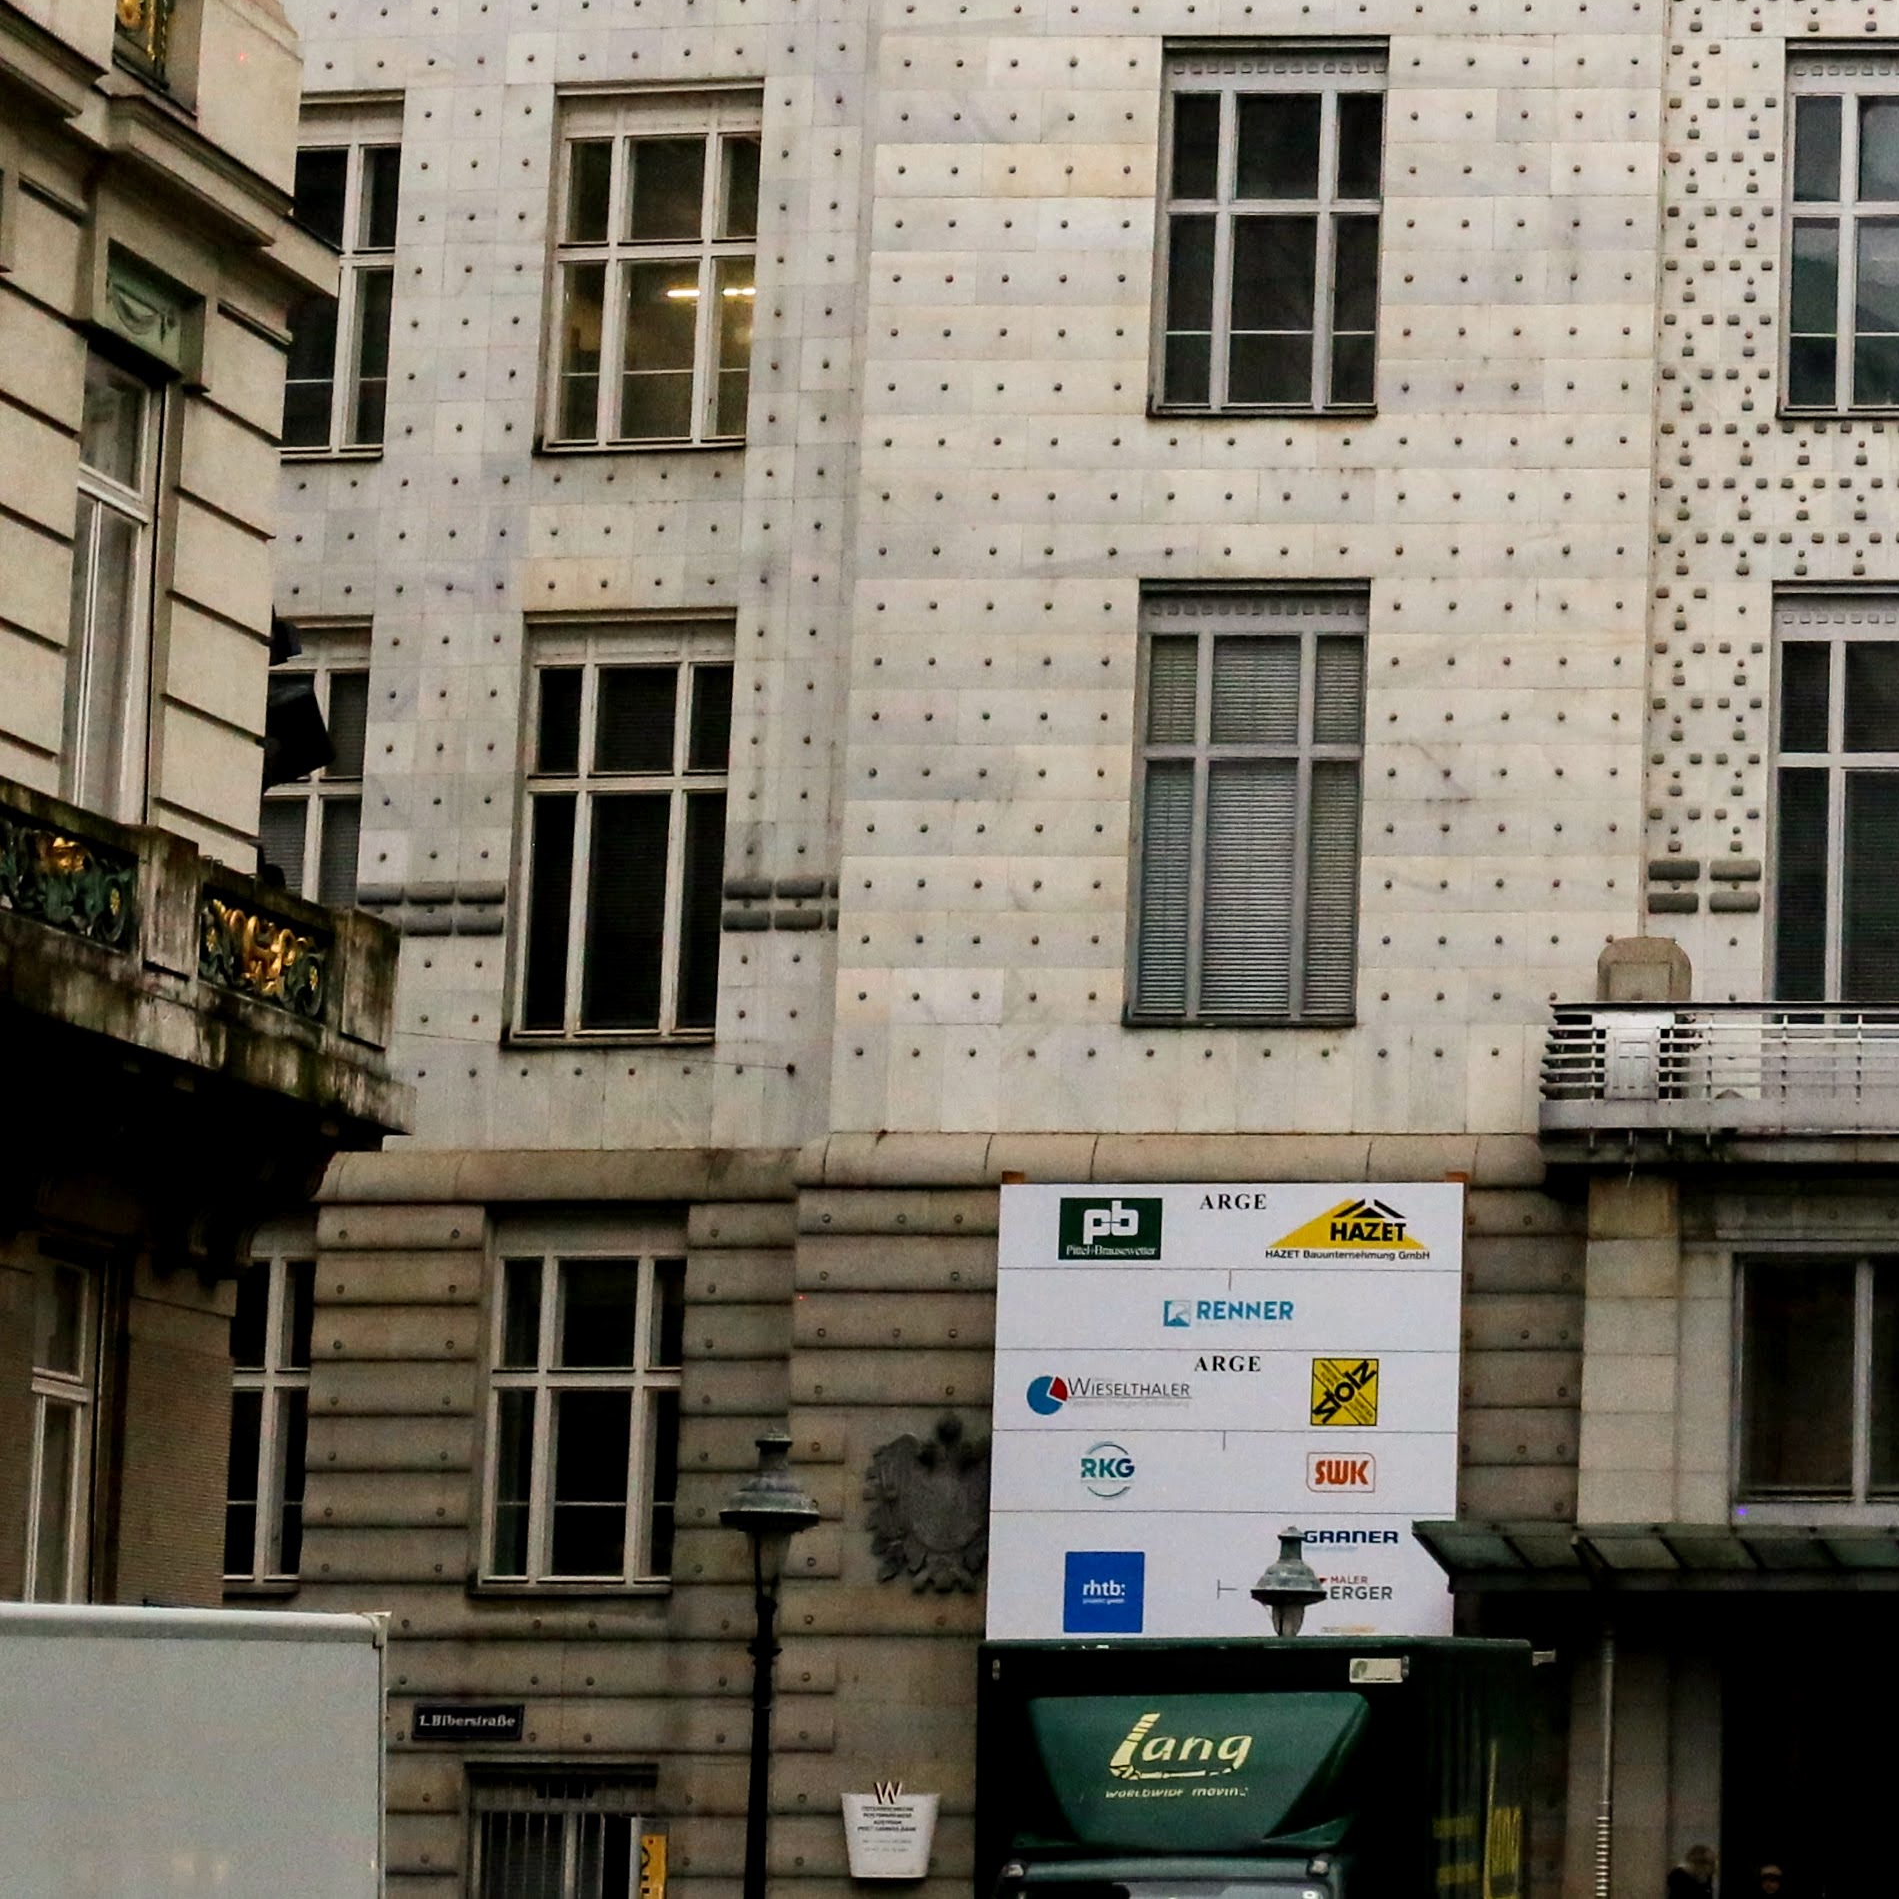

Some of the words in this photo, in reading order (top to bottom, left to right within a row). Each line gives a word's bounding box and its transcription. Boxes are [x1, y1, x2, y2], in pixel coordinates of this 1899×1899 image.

[1199, 1193, 1267, 1210] ARGE
[1083, 1200, 1139, 1245] pb
[1330, 1222, 1407, 1242] HAZET
[1265, 1250, 1304, 1259] HAZET
[1303, 1250, 1396, 1262] Bauunternehmung
[1397, 1251, 1430, 1261] GmbH
[1196, 1300, 1295, 1320] RENNER
[1194, 1355, 1262, 1373] ARGE
[1080, 1457, 1135, 1478] RKG
[1314, 1460, 1370, 1485] SWK
[1082, 1579, 1126, 1596] rhtb:
[1329, 1575, 1368, 1585] MALER
[1328, 1585, 1393, 1600] ERGER
